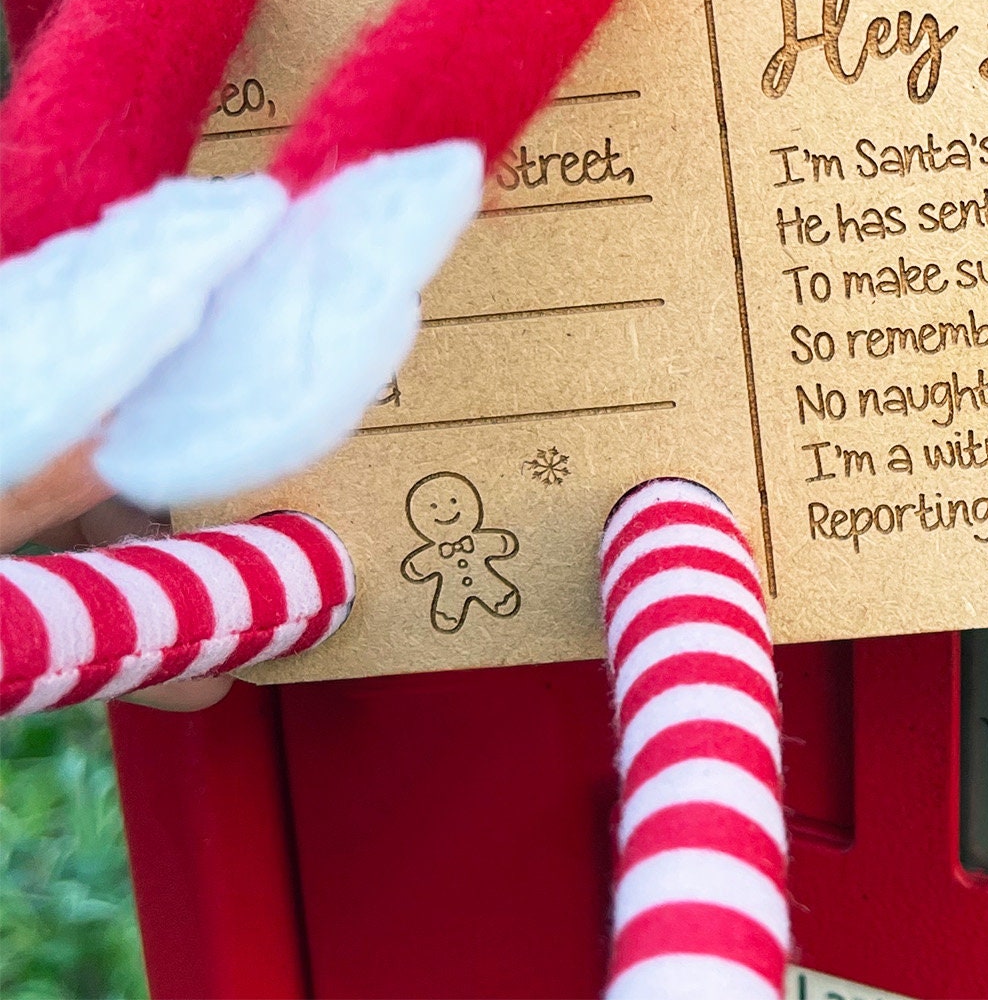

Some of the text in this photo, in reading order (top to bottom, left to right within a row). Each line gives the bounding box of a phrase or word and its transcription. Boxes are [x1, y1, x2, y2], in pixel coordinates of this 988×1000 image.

[211, 77, 277, 119] eo,
[496, 137, 635, 191] Street,
[769, 144, 846, 188] I'm
[775, 205, 831, 247] He
[836, 202, 907, 245] has
[782, 265, 832, 306] To
[842, 255, 950, 300] make
[790, 323, 836, 366] So
[795, 382, 847, 426] No
[801, 440, 876, 484] I'm
[886, 443, 913, 476] a
